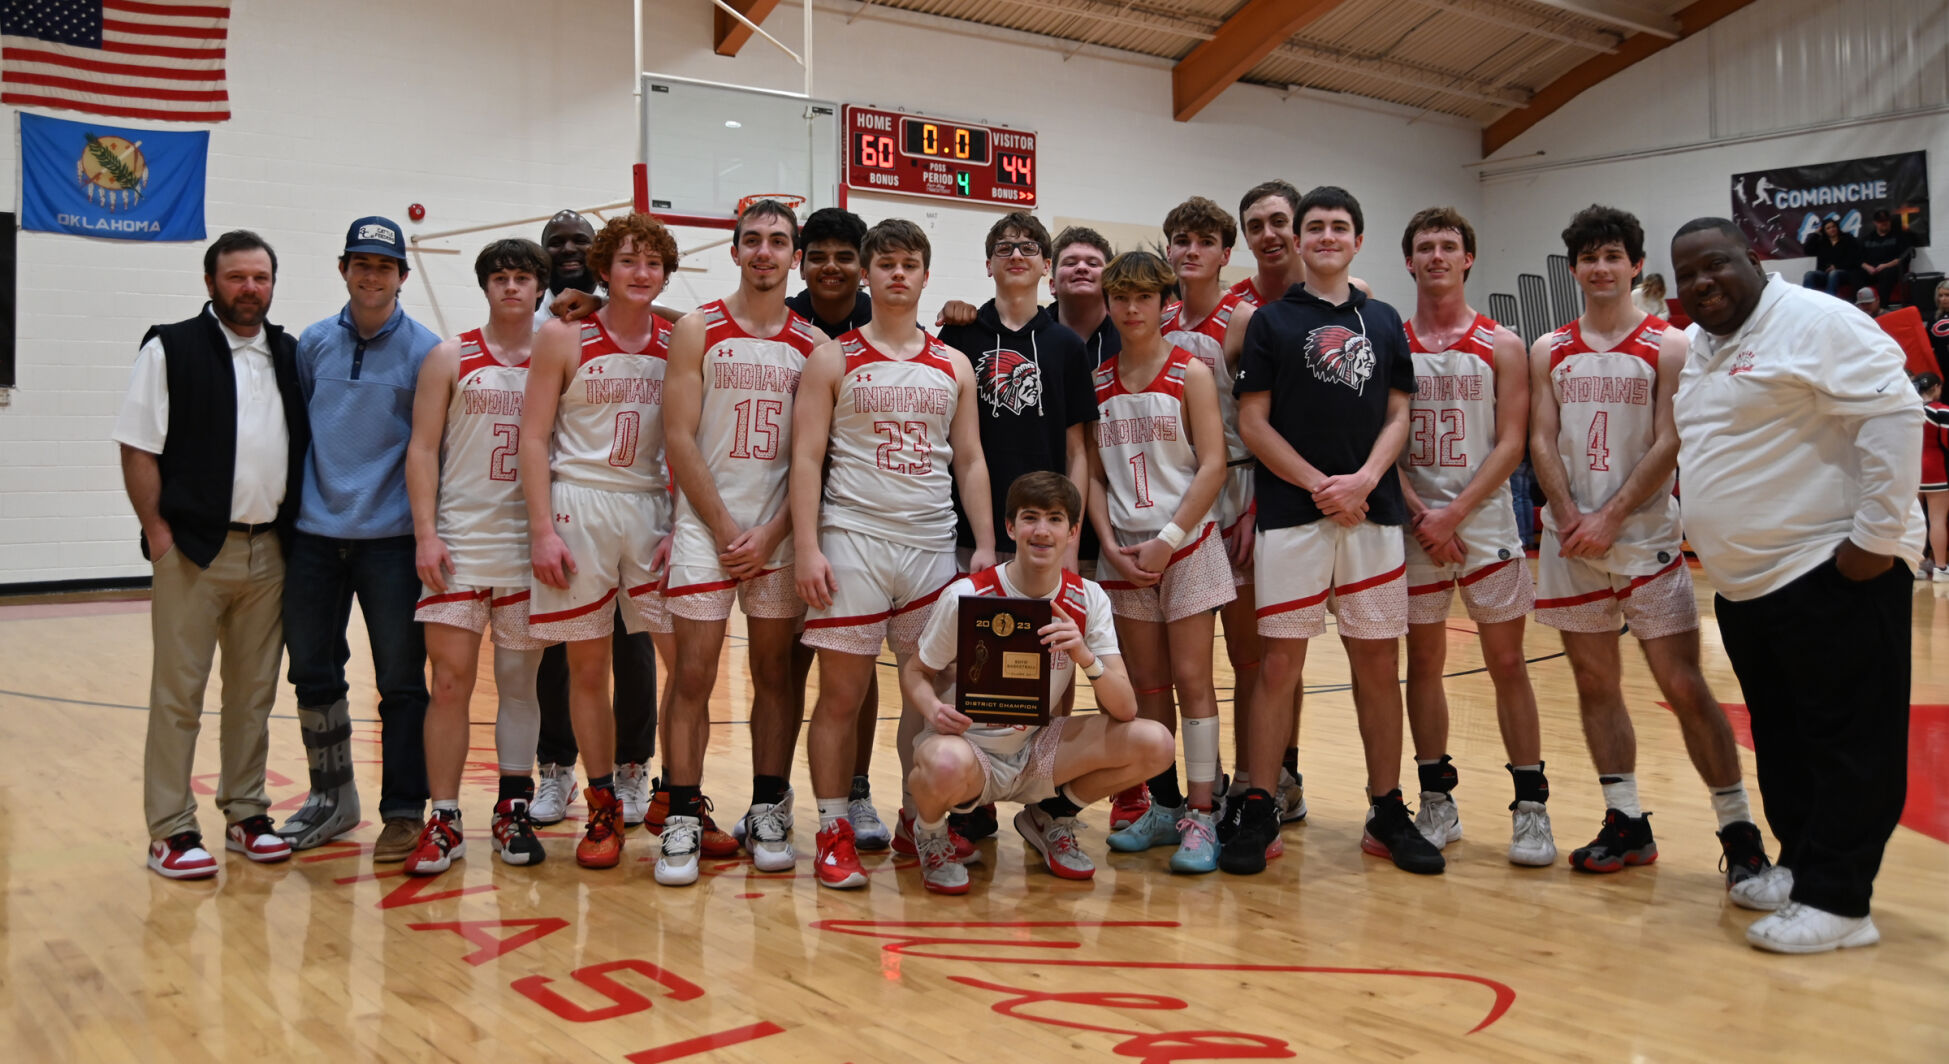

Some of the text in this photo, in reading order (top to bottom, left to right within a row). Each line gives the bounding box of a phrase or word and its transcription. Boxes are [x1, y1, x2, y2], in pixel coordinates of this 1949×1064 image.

[856, 112, 892, 131] HOME
[861, 134, 894, 169] 60
[923, 123, 969, 159] 0.0
[993, 132, 1034, 151] VISITOR
[869, 172, 899, 186] BONUS
[922, 171, 953, 185] PERIOD
[929, 162, 946, 172] POSS
[1002, 155, 1032, 186] 44
[957, 172, 970, 195] 4
[992, 187, 1018, 200] BONUS
[1775, 180, 1887, 208] COMANCHE
[57, 213, 161, 233] OKLAHOMA
[585, 378, 664, 405] INDIAN
[853, 386, 948, 415] INDIANS
[1410, 375, 1483, 401] DIANS
[1558, 376, 1648, 405] NDIANS
[463, 389, 524, 416] INDIA
[609, 411, 640, 467] 0
[730, 399, 782, 460] 15
[1410, 409, 1466, 467] 32
[1587, 411, 1609, 471] 4
[490, 423, 519, 481] 2
[874, 421, 932, 475] 23
[1130, 451, 1153, 508] 1
[976, 620, 1031, 630] 20 23
[965, 700, 1038, 710] DISTRICT CHAMPION
